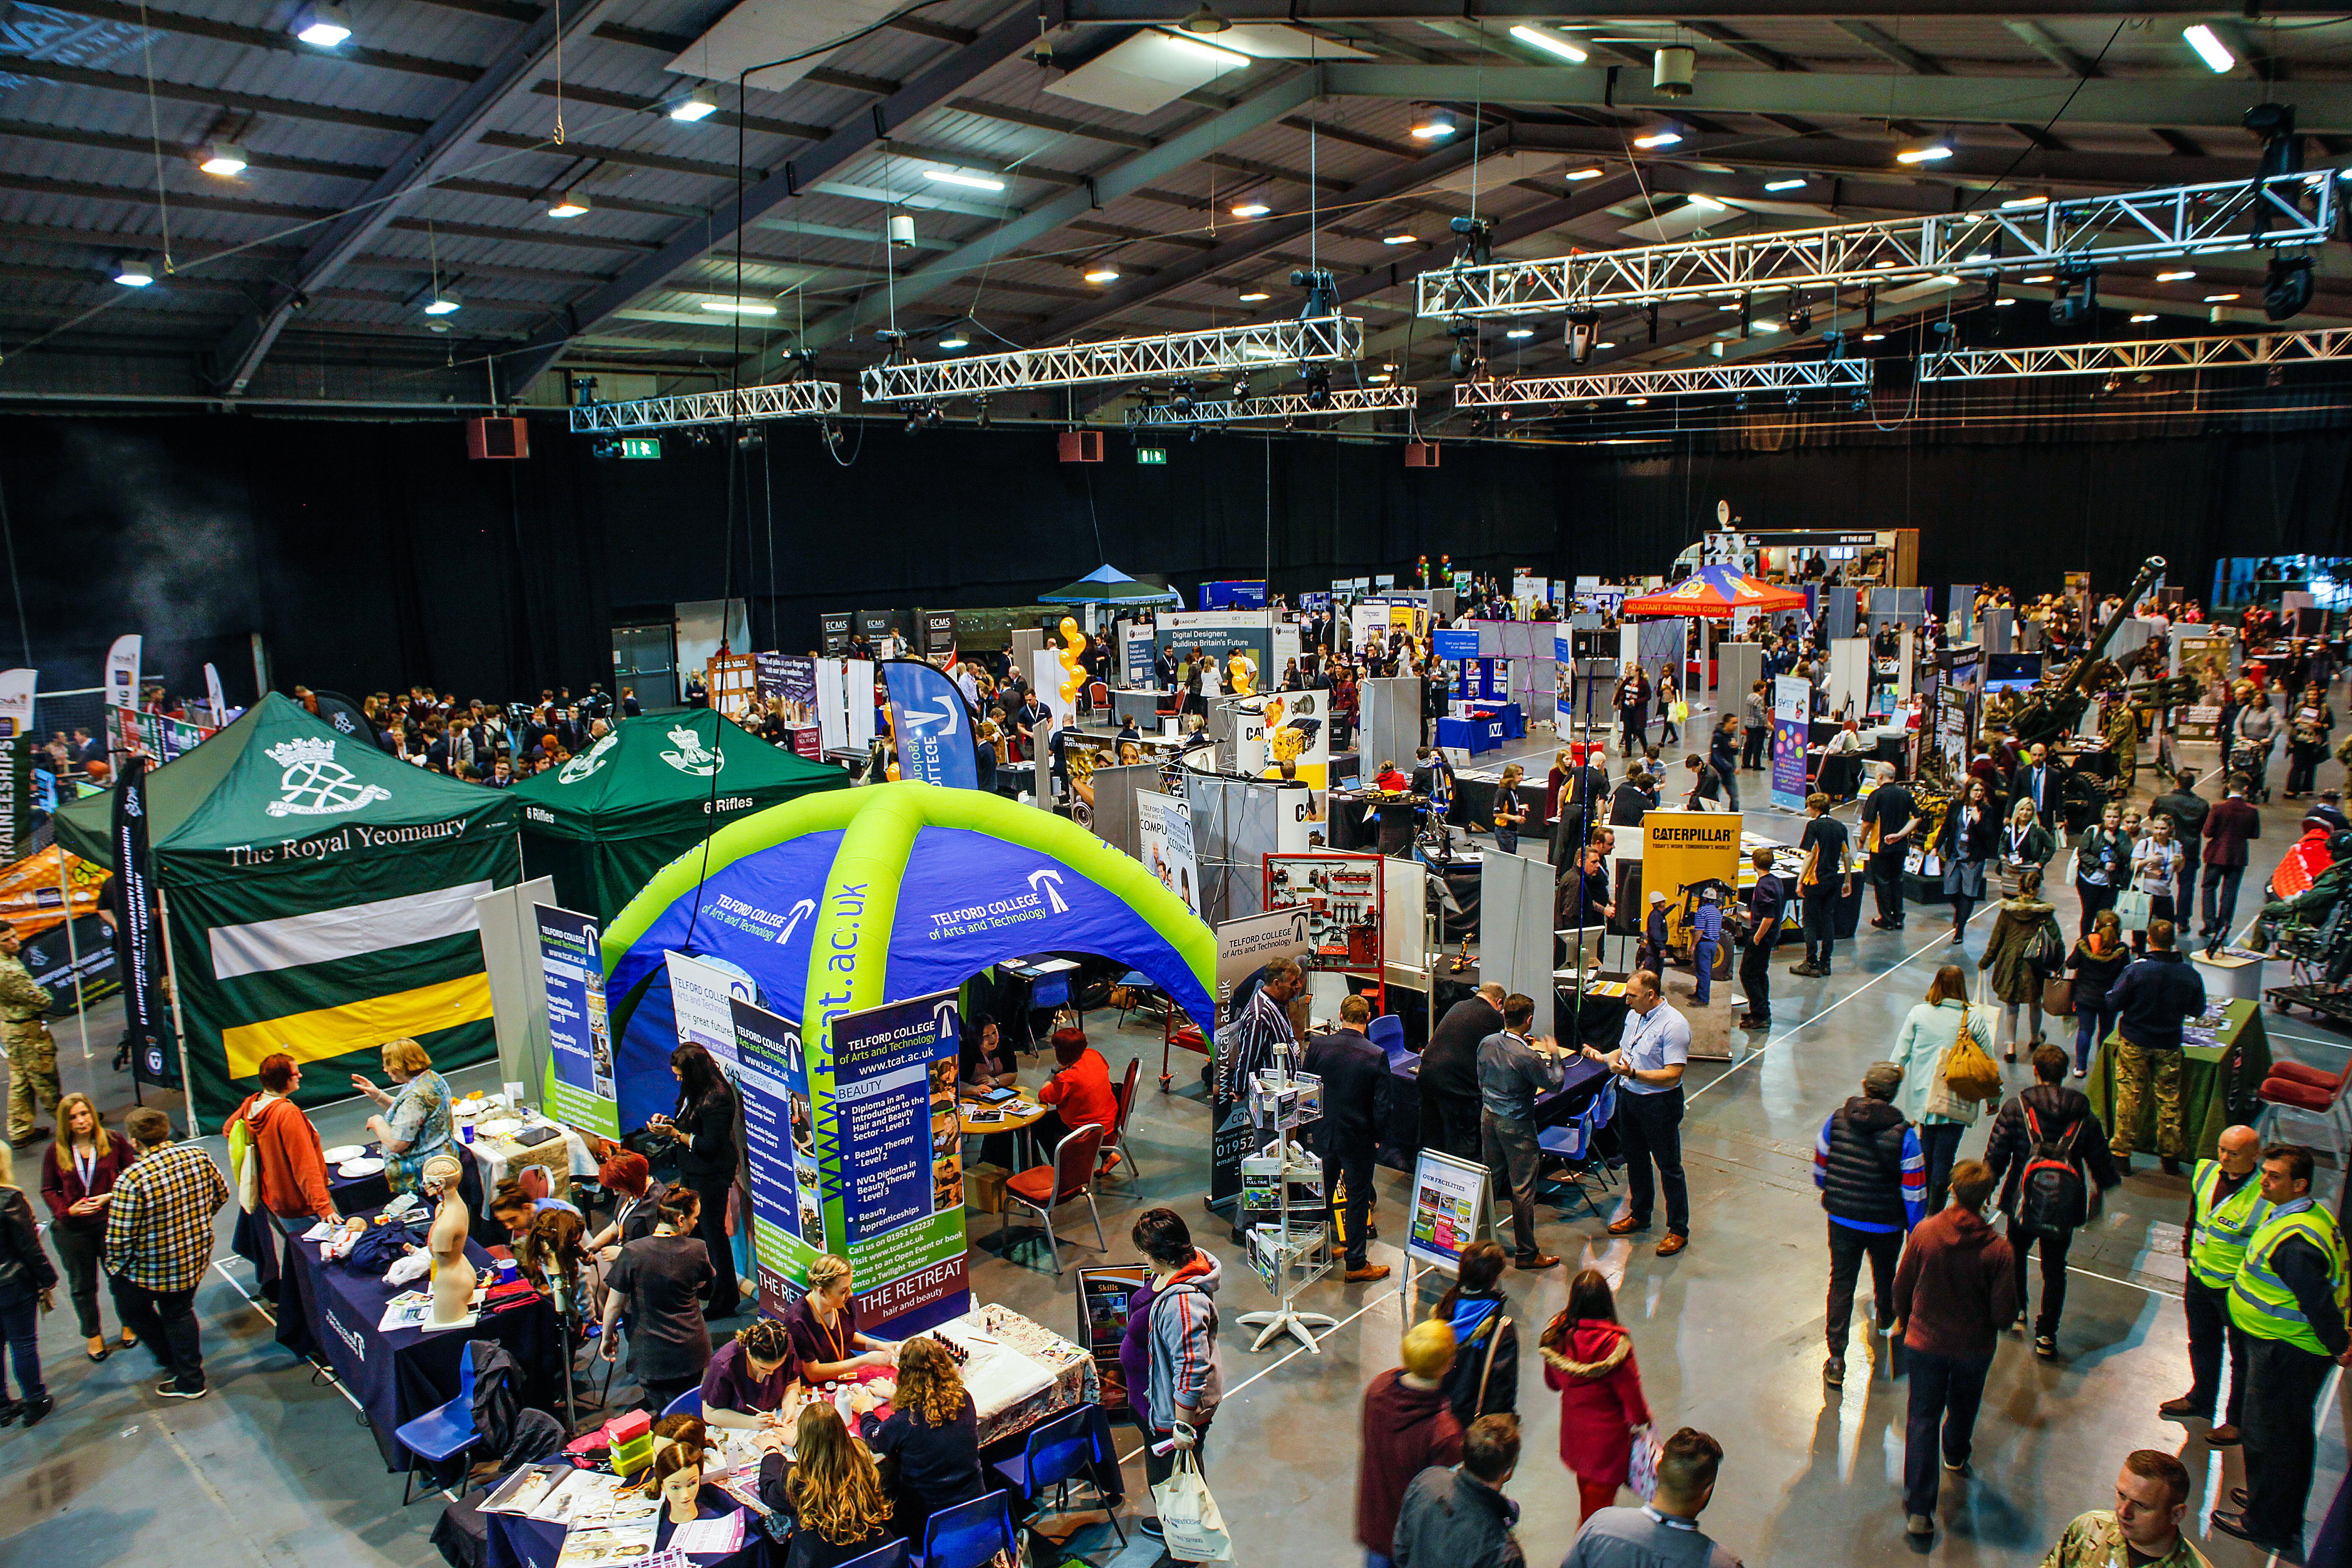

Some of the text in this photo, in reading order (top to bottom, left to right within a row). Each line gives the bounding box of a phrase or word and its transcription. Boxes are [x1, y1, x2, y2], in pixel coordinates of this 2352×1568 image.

[826, 621, 847, 629] ECMS
[930, 618, 950, 627] ECMS
[1173, 631, 1227, 640] Digital Designers
[1065, 742, 1099, 750] SUSTAINABILITY
[0, 740, 15, 863] TRAINEESHIPS
[704, 797, 753, 814] 6 Rifles
[1143, 805, 1160, 813] TELFORD
[526, 807, 554, 824] 6 Rifles
[1140, 819, 1167, 835] COMPU
[226, 818, 467, 867] The Royal Yeomanry
[1653, 828, 1730, 841] CATERPILLAR
[122, 824, 134, 883] SQUADRON
[135, 871, 149, 930] YEOMANRY
[717, 894, 787, 928] TELFORD COLLEGE
[930, 893, 1042, 926] TELFORD COLLEGE
[1723, 908, 1735, 917] CAT
[126, 885, 141, 947] YEOMANRY)
[701, 905, 776, 941] of Arts and Technology
[929, 908, 1046, 940] of Arts and Technology
[542, 926, 586, 944] TELFORD COLLEGE
[1230, 928, 1291, 947] TELFORD COLLEGE
[1245, 945, 1256, 954] and
[1258, 939, 1291, 950] Technology
[548, 949, 587, 965] www.tcat.ac.uk
[674, 977, 729, 1005] TELFORD COLLEG
[677, 991, 731, 1021] Arts and Technolog
[693, 1015, 709, 1028] great
[711, 1020, 733, 1037] futures
[848, 1021, 935, 1051] TELFORD COLLEGE
[691, 1033, 738, 1060] Health and Socia
[737, 1025, 787, 1056] TELFORD COLLEGE
[840, 1034, 935, 1064] of Arts and Technology
[1218, 979, 1231, 1104] www.tcat.ac.uk
[740, 1038, 788, 1068] Arts and Technology
[859, 1047, 934, 1075] www.tcat.ac.uk
[745, 1055, 789, 1082] www.tcat.ac.uk
[839, 1080, 882, 1099] BEAUTY
[852, 1100, 885, 1114] Diploma
[896, 1094, 905, 1102] an
[852, 1103, 900, 1123] Introduction
[853, 1109, 913, 1132] Hair and Beauty
[854, 1130, 879, 1141] Sector
[886, 1120, 904, 1132] Level
[855, 1135, 913, 1159] Beauty Therapy
[1217, 1136, 1254, 1157] 01952
[861, 1155, 881, 1167] Level
[1217, 1155, 1236, 1166] email:
[856, 1174, 875, 1186] NVQ
[877, 1164, 908, 1180] Diploma
[857, 1170, 916, 1195] Beauty Therapy
[1435, 1178, 1465, 1191] FACILITIES
[864, 1191, 883, 1202] Level
[859, 1207, 886, 1221] Beauty
[860, 1206, 919, 1233] Apprenticeships
[1438, 1217, 1452, 1225] SPORT
[848, 1245, 864, 1254] Call
[887, 1229, 908, 1243] 01952
[910, 1218, 935, 1233] 642237
[850, 1235, 924, 1265] Visit www.tcat.ac.uk
[852, 1266, 873, 1277] Come
[875, 1262, 882, 1270] to
[895, 1250, 913, 1261] Open
[915, 1242, 934, 1254] Event
[945, 1231, 963, 1242] book
[757, 1269, 779, 1296] THE
[852, 1279, 870, 1289] onto
[877, 1263, 905, 1279] Twilight
[907, 1256, 928, 1268] Taster
[858, 1259, 963, 1313] THE RETREAT
[883, 1287, 943, 1317] hair and beauty
